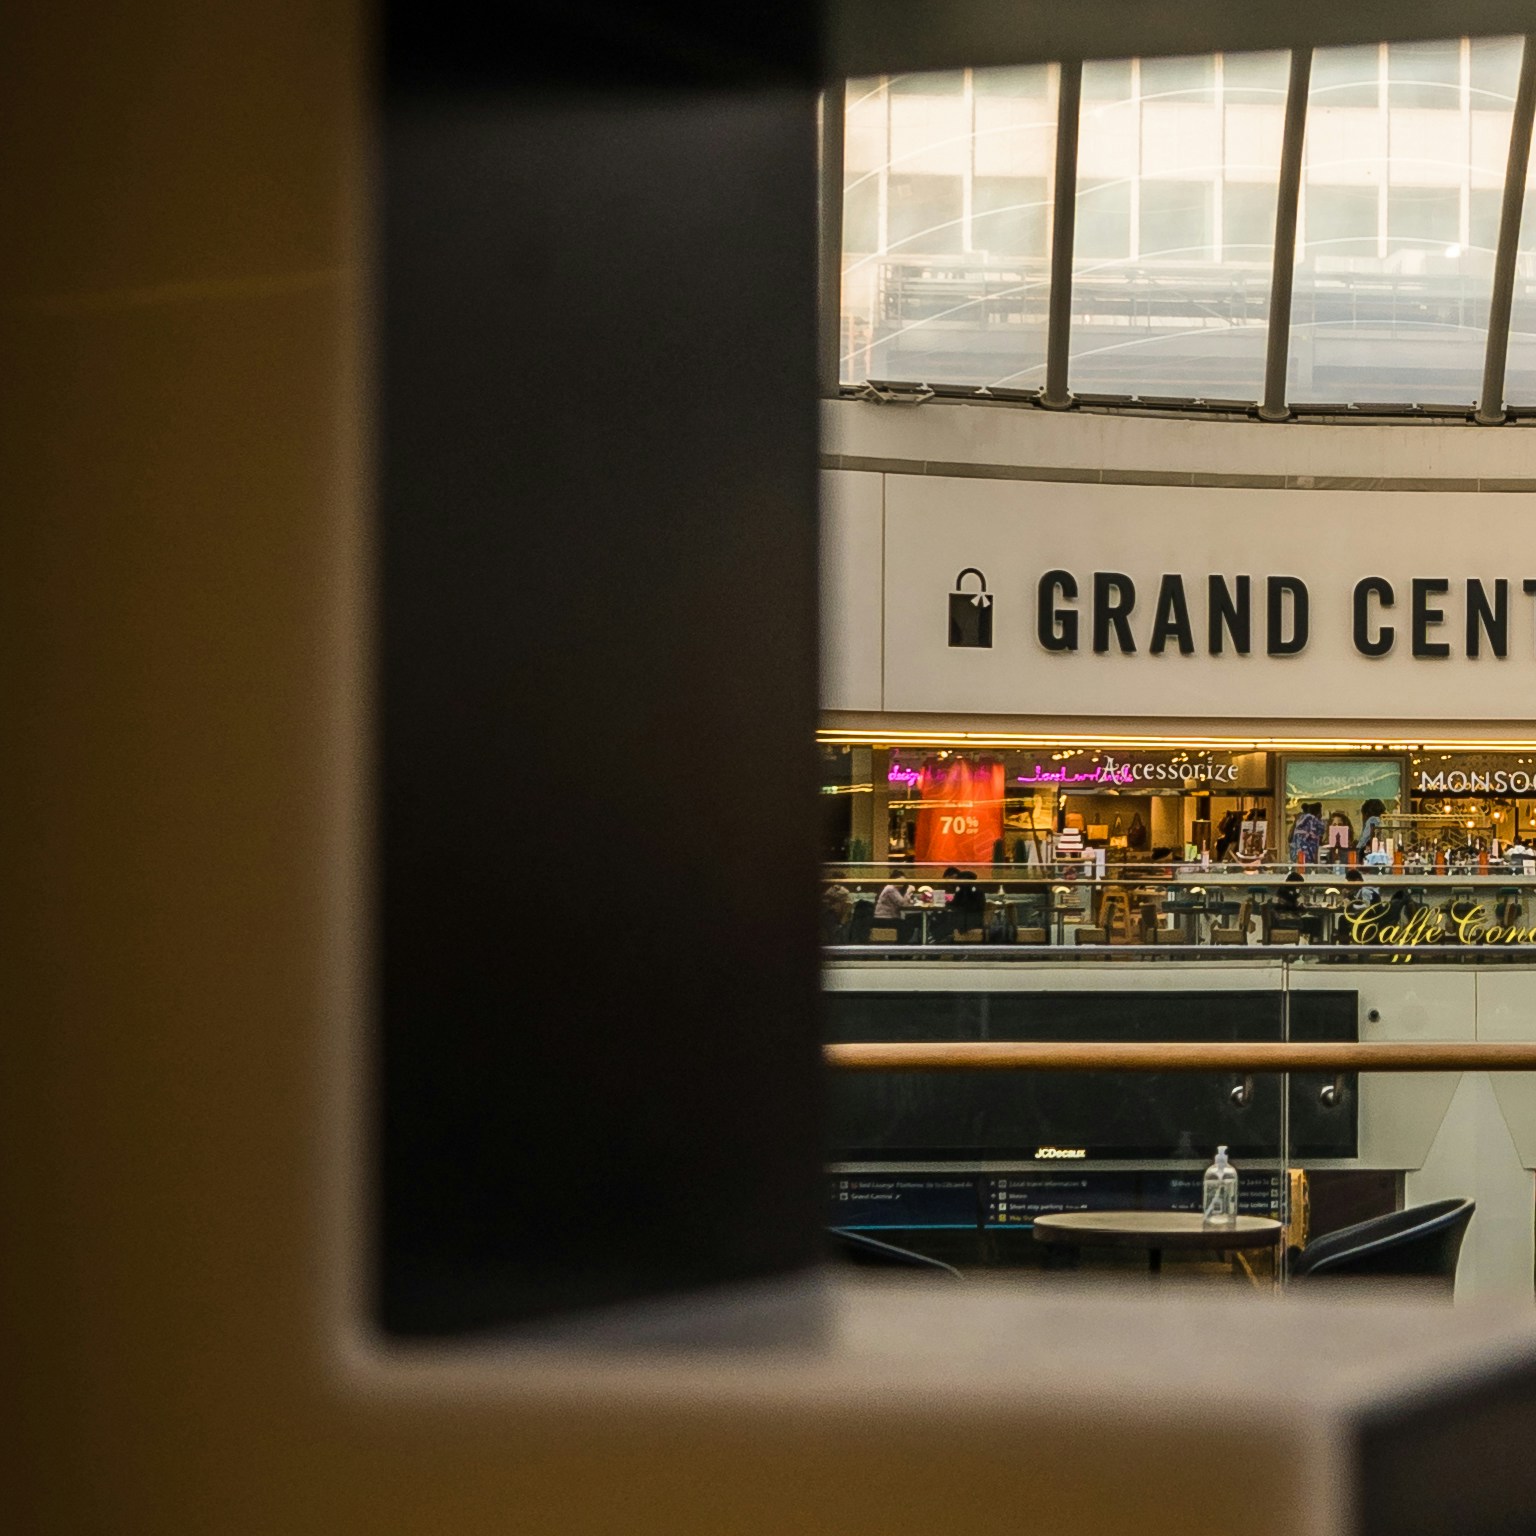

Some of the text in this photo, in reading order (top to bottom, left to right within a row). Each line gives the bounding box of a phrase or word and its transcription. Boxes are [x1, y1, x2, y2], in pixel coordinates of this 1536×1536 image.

[1037, 568, 1310, 655] GRAND
[1098, 755, 1239, 785] Accessorize
[940, 816, 979, 835] 70%
